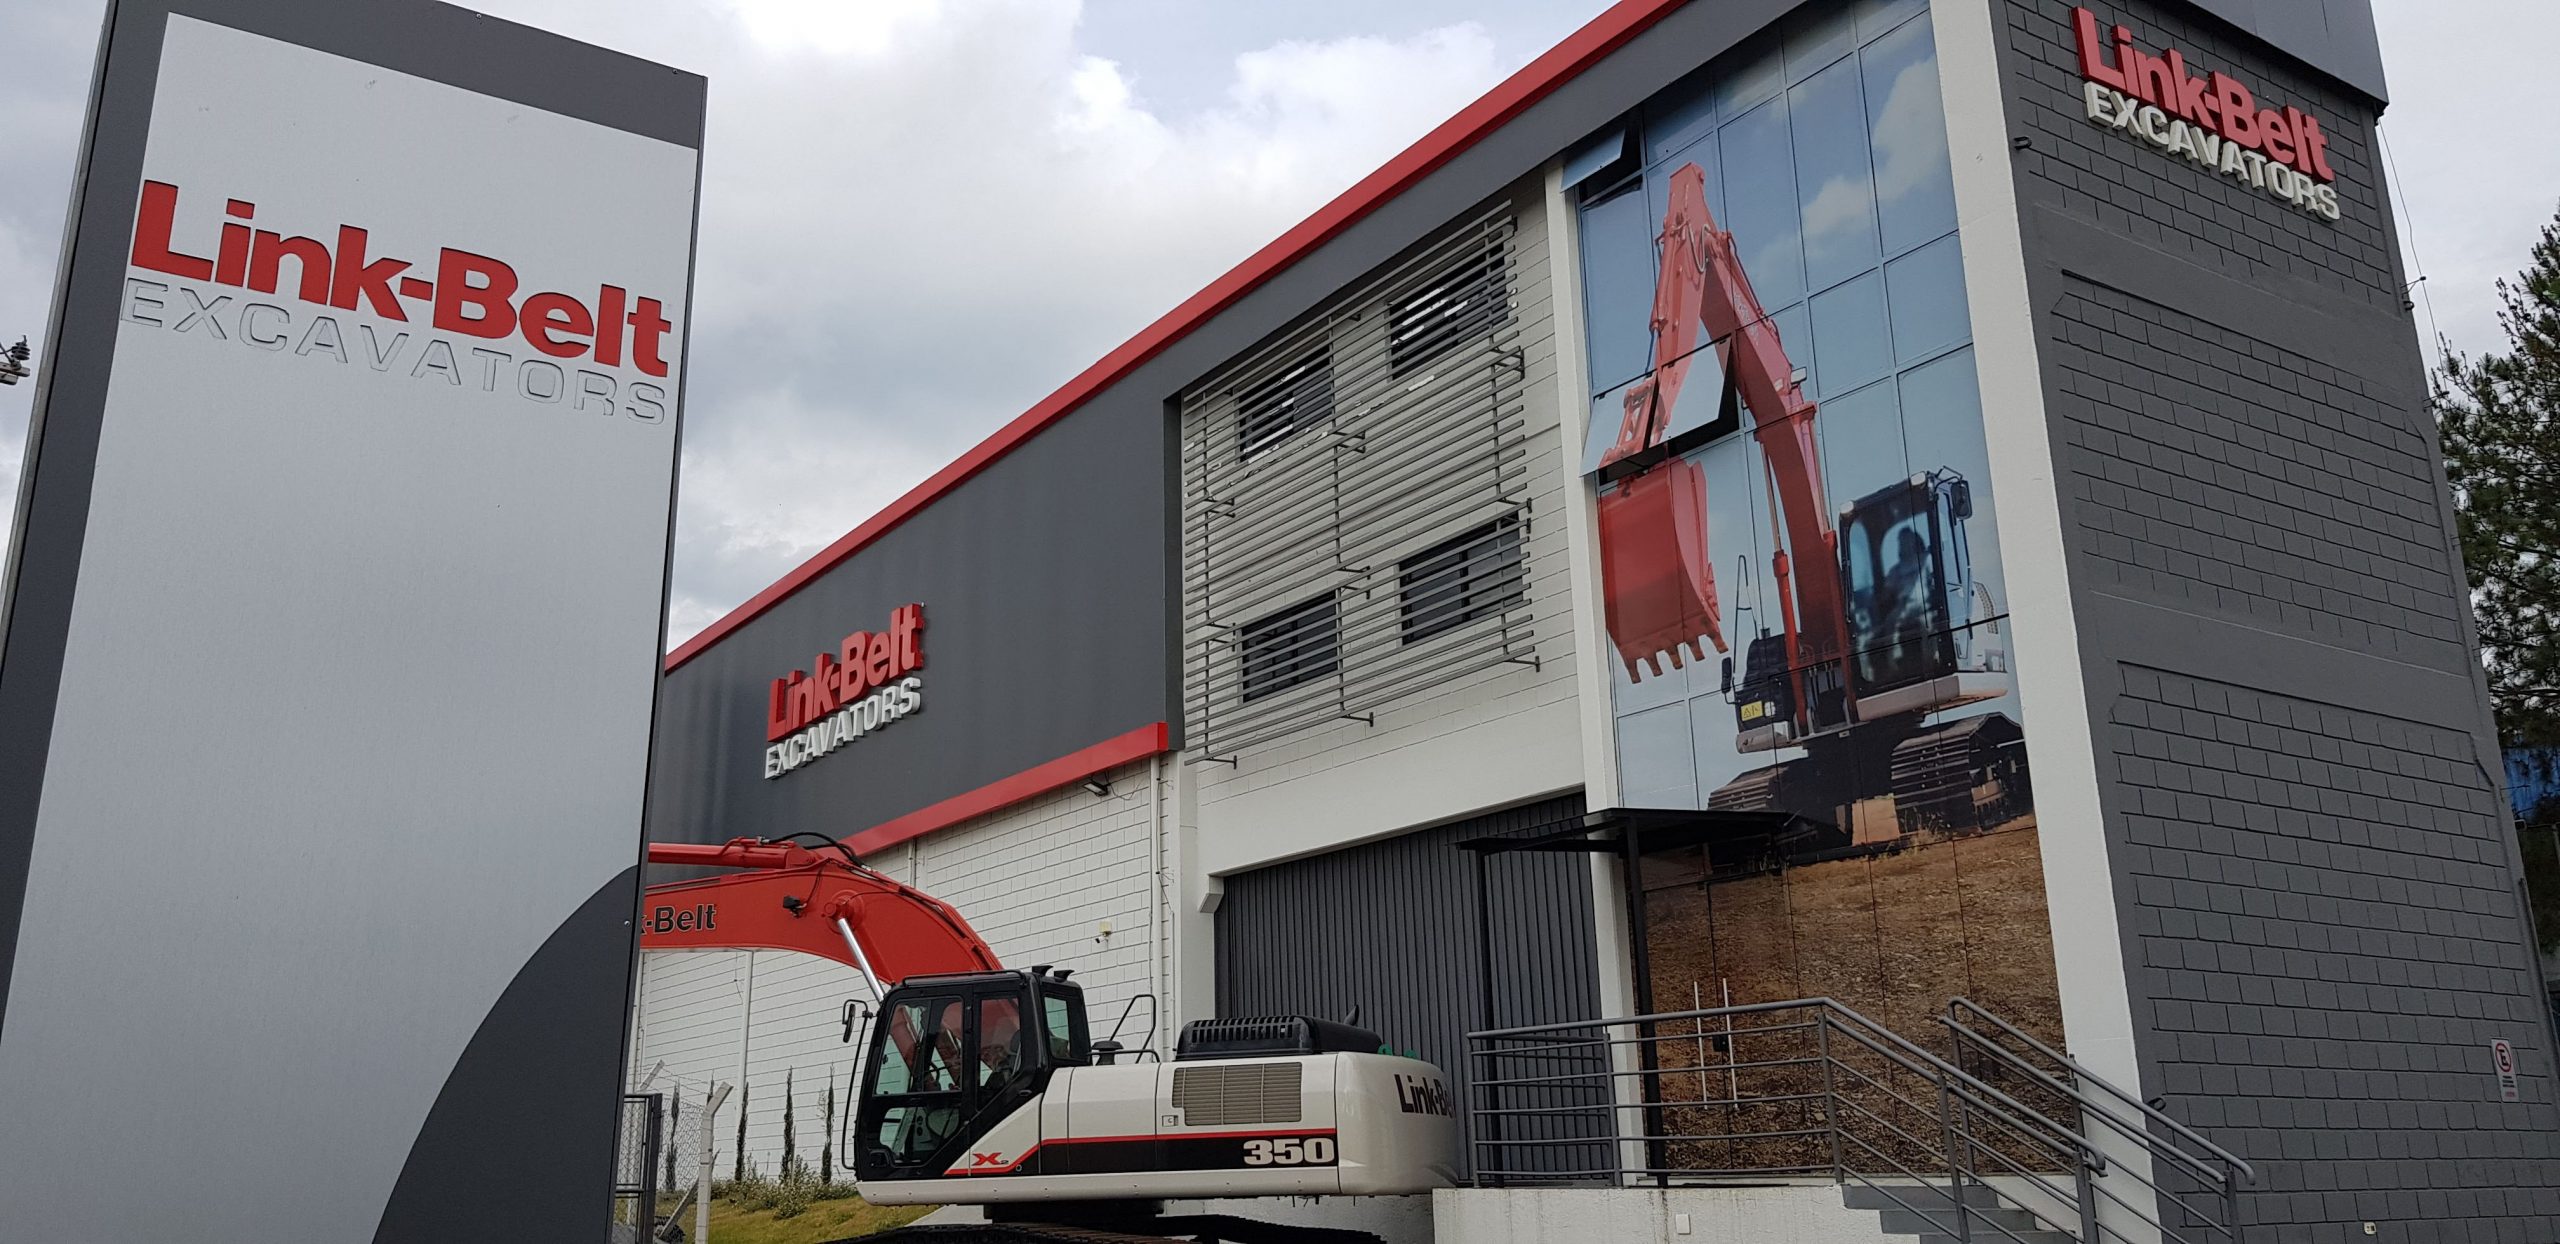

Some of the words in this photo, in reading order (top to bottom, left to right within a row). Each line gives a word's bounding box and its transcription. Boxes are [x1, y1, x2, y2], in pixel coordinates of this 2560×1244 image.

[2070, 6, 2336, 182] Link-Belt
[2083, 80, 2341, 221] EXCAVATORS
[131, 179, 672, 378] Link-Belt
[120, 276, 668, 426] EXCAVATORS
[764, 677, 922, 780] EXCAVATORS
[767, 603, 924, 743] Link-Belt
[1243, 1137, 1335, 1166] 350
